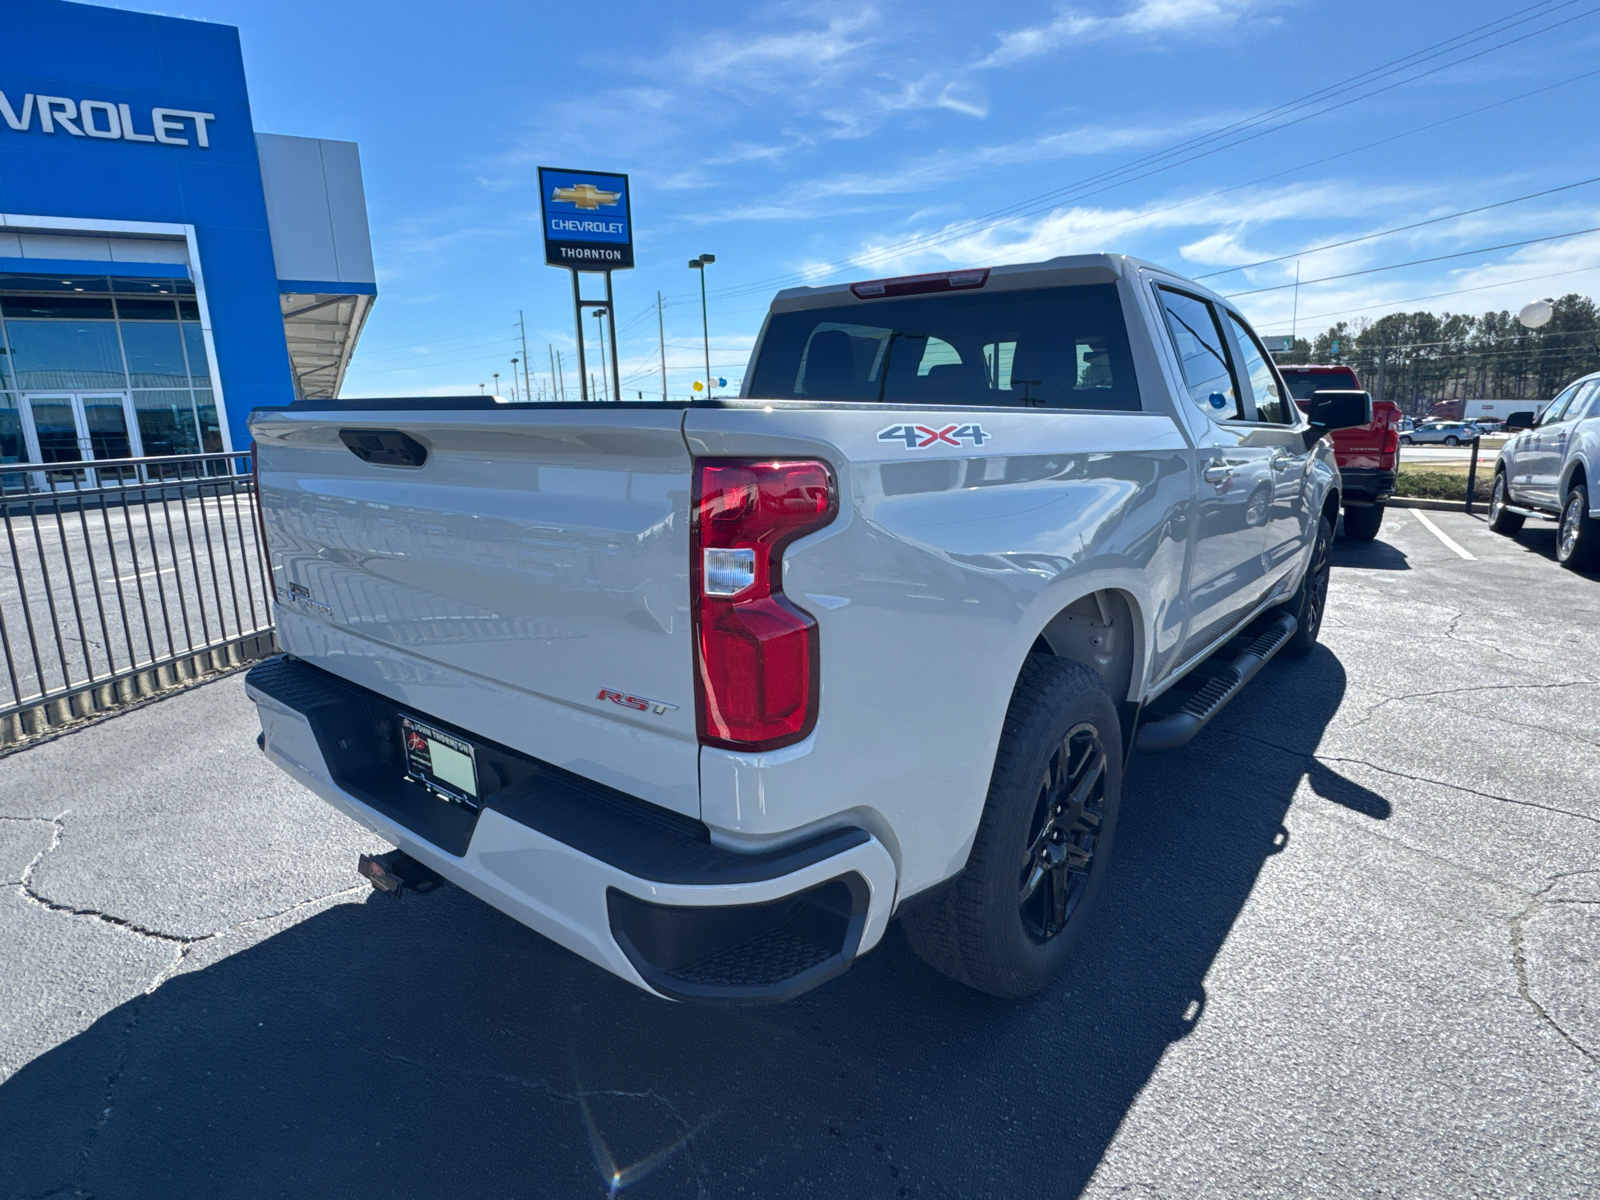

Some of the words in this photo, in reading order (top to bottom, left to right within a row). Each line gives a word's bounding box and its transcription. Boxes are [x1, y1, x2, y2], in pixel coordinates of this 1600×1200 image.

[551, 219, 624, 233] CHEVROLET
[560, 247, 621, 260] THORNTON
[596, 687, 679, 715] RST
[414, 723, 432, 737] JOHN
